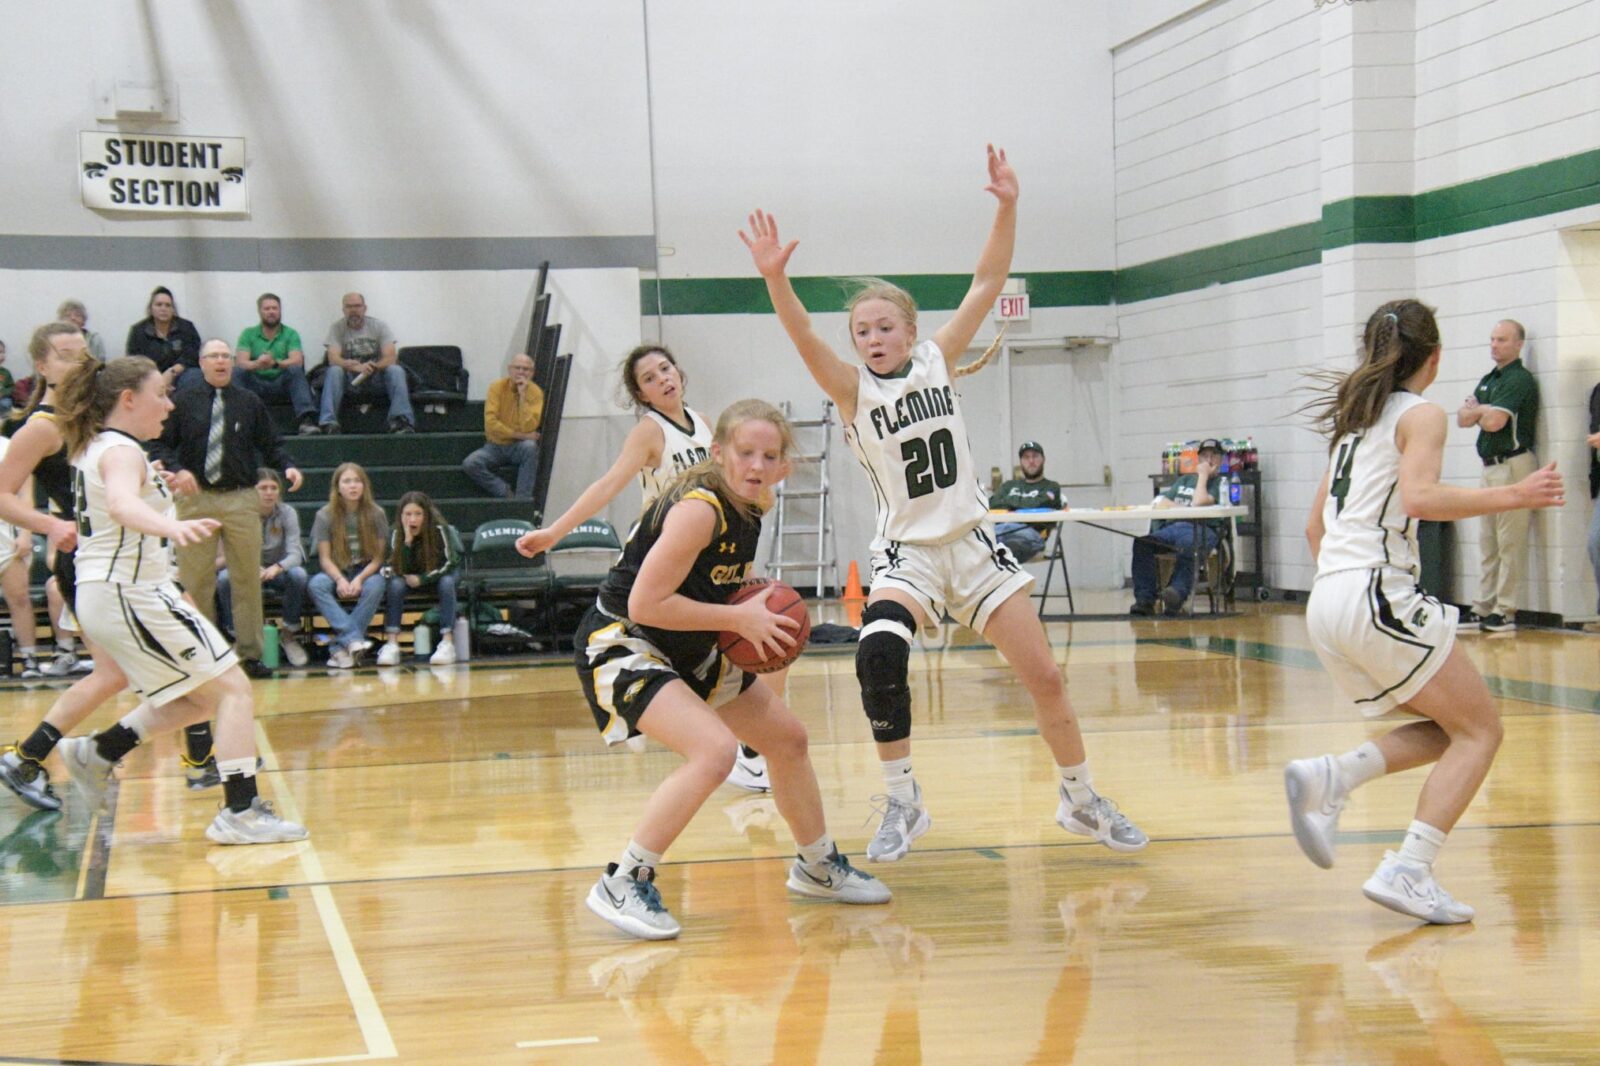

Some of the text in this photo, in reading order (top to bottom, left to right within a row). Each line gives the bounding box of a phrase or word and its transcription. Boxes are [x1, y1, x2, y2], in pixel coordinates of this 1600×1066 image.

[105, 137, 222, 170] STUDENT
[109, 177, 221, 207] SECTION
[1001, 297, 1024, 317] EXIT
[870, 385, 954, 440] FLEMING
[901, 427, 957, 499] 20
[1330, 436, 1361, 520] 4
